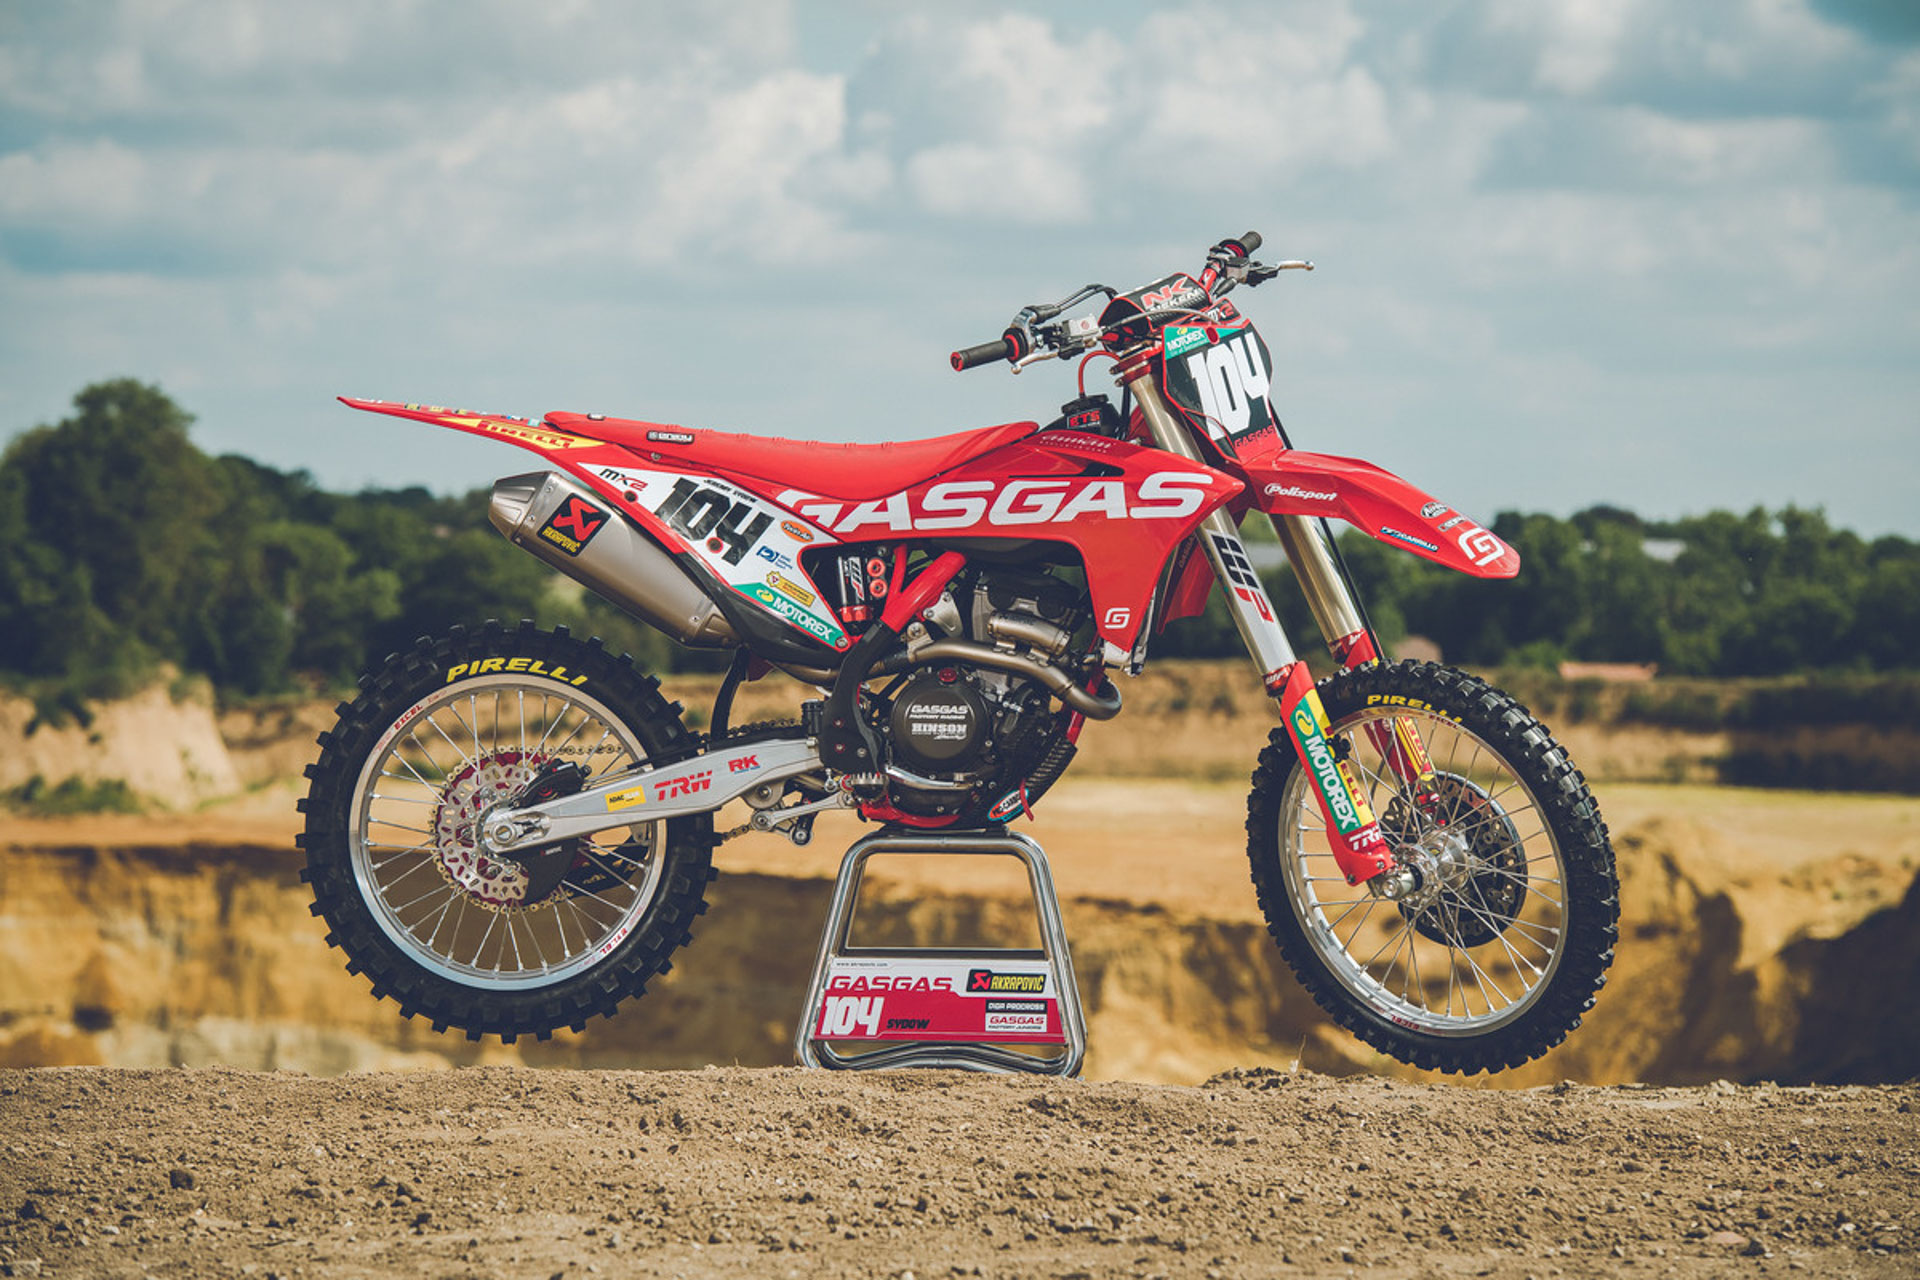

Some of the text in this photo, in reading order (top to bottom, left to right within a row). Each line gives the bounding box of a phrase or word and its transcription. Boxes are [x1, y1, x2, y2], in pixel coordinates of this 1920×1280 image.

[1141, 276, 1194, 311] NK
[1166, 329, 1205, 351] MOTOREX
[1187, 331, 1272, 441] 104
[1069, 409, 1100, 427] ETS
[776, 472, 1213, 532] GASGAS
[1271, 483, 1337, 501] Polisport
[654, 477, 775, 567] 104
[773, 596, 834, 640] MOTOREX
[446, 657, 588, 686] PIRELLI
[911, 705, 968, 714] GASGAS
[911, 723, 967, 732] HINSON
[728, 755, 759, 772] RK
[654, 770, 713, 801] TRW
[1305, 735, 1358, 830] MOTOREX
[829, 975, 953, 993] GASGAS
[821, 996, 885, 1036] 104
[886, 1018, 930, 1030] SYDOW
[990, 1015, 1045, 1025] GASGAS
